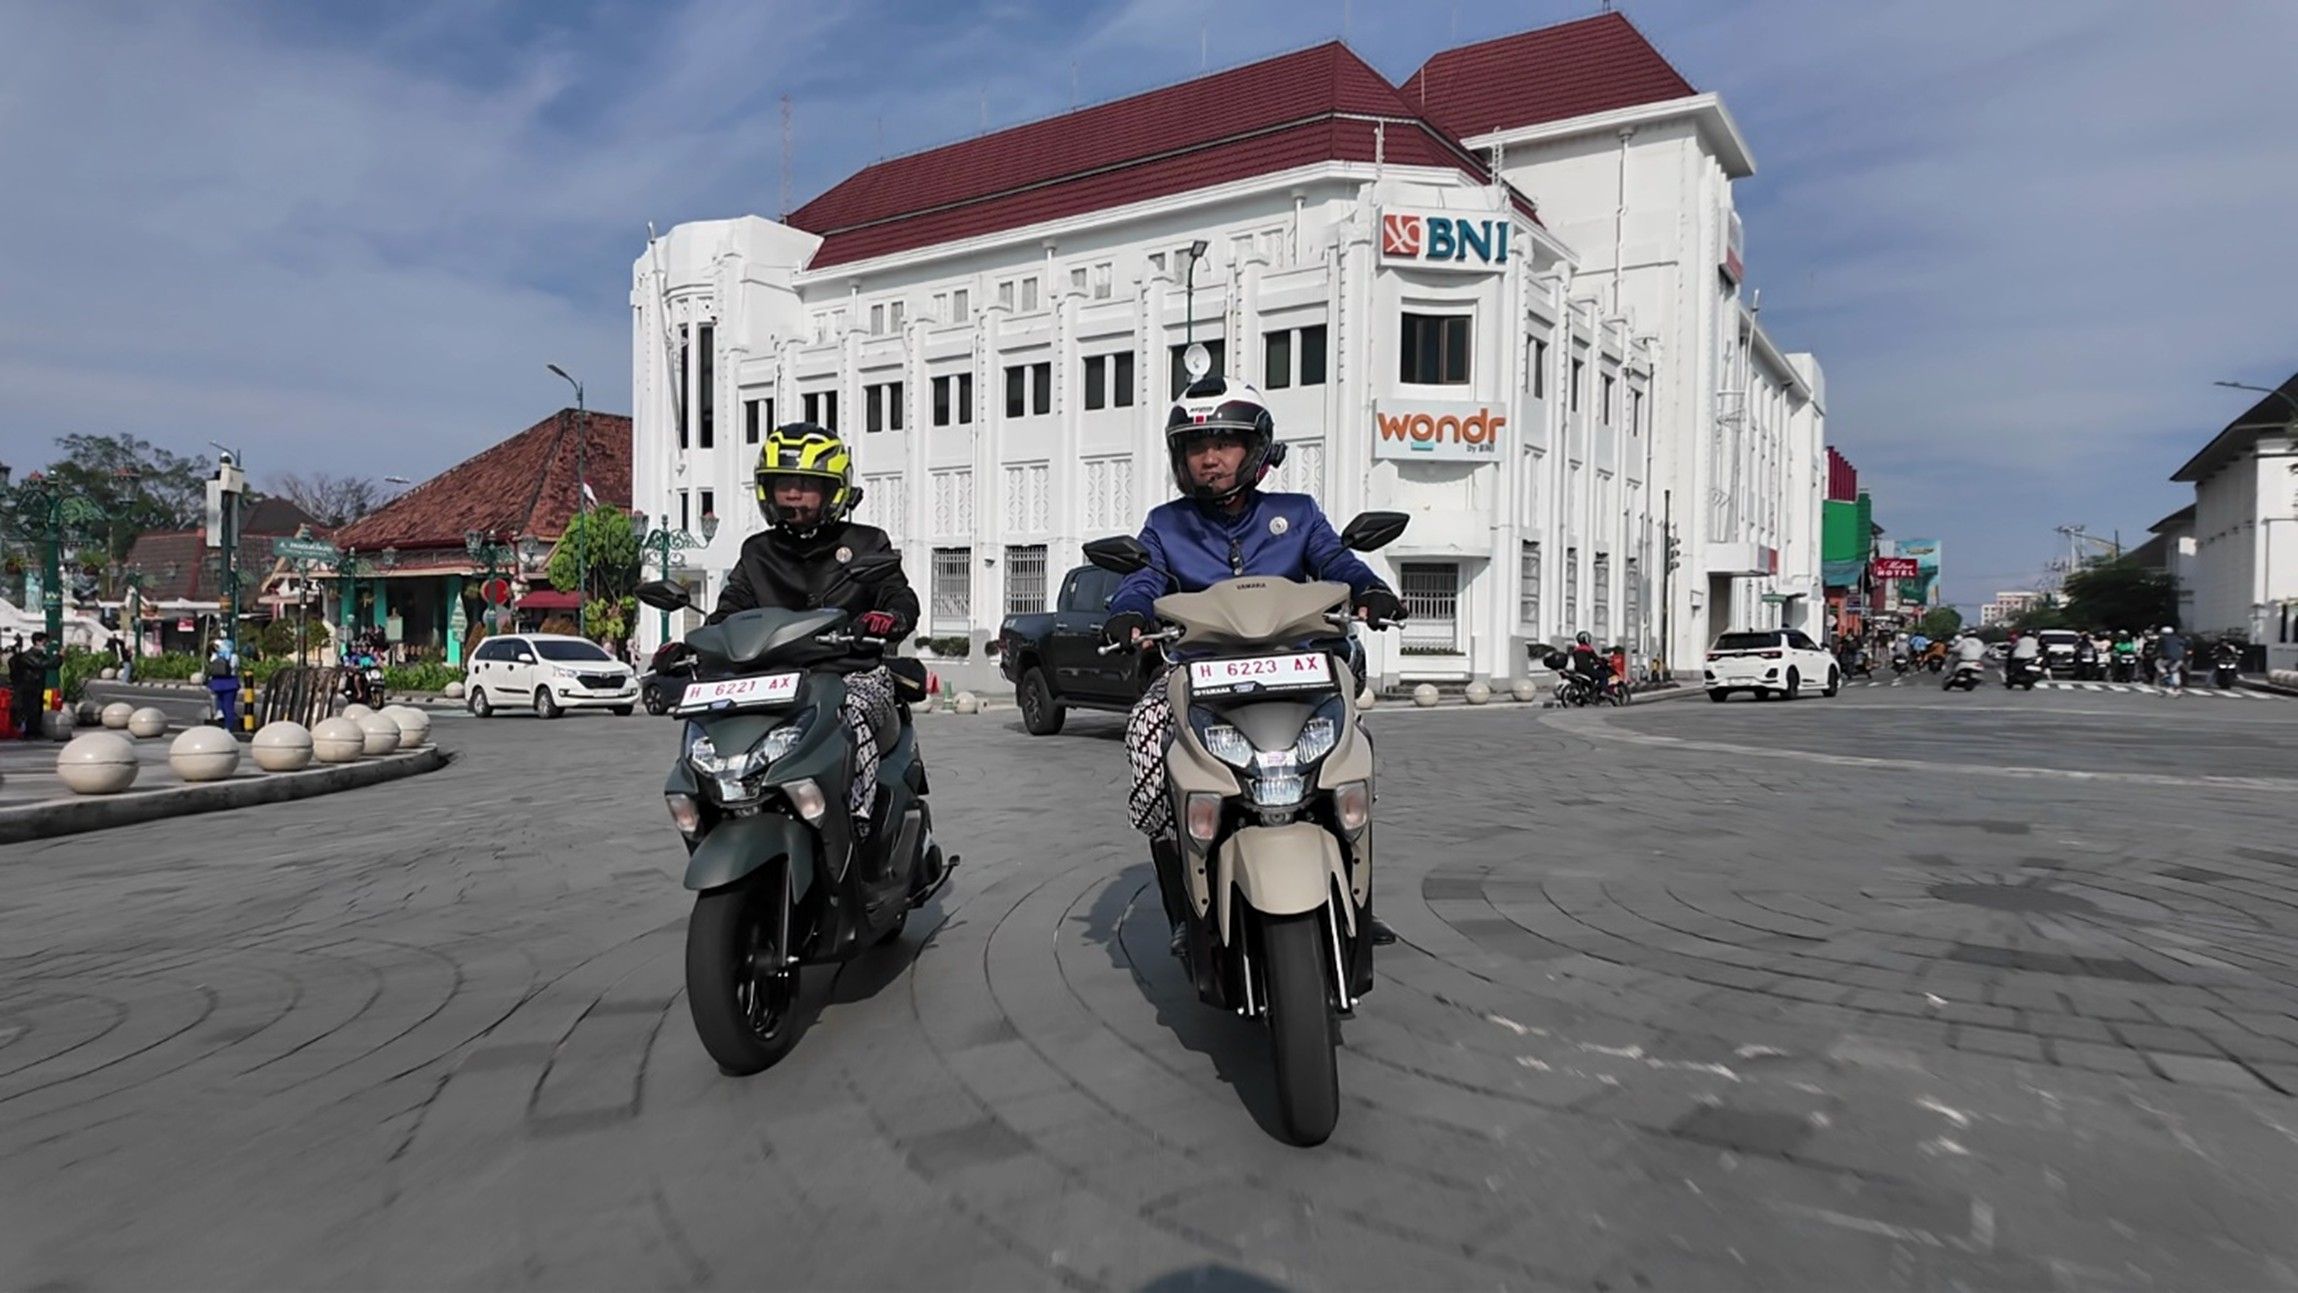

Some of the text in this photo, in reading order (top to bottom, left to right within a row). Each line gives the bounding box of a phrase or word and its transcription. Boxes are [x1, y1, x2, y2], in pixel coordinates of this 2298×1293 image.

[1426, 217, 1509, 264] BNI
[1377, 408, 1506, 444] wondr
[1466, 444, 1495, 453] by BNI
[1877, 569, 1915, 577] HOTEL
[1200, 656, 1318, 678] H 6223 AX
[690, 676, 791, 698] H 6221 AX
